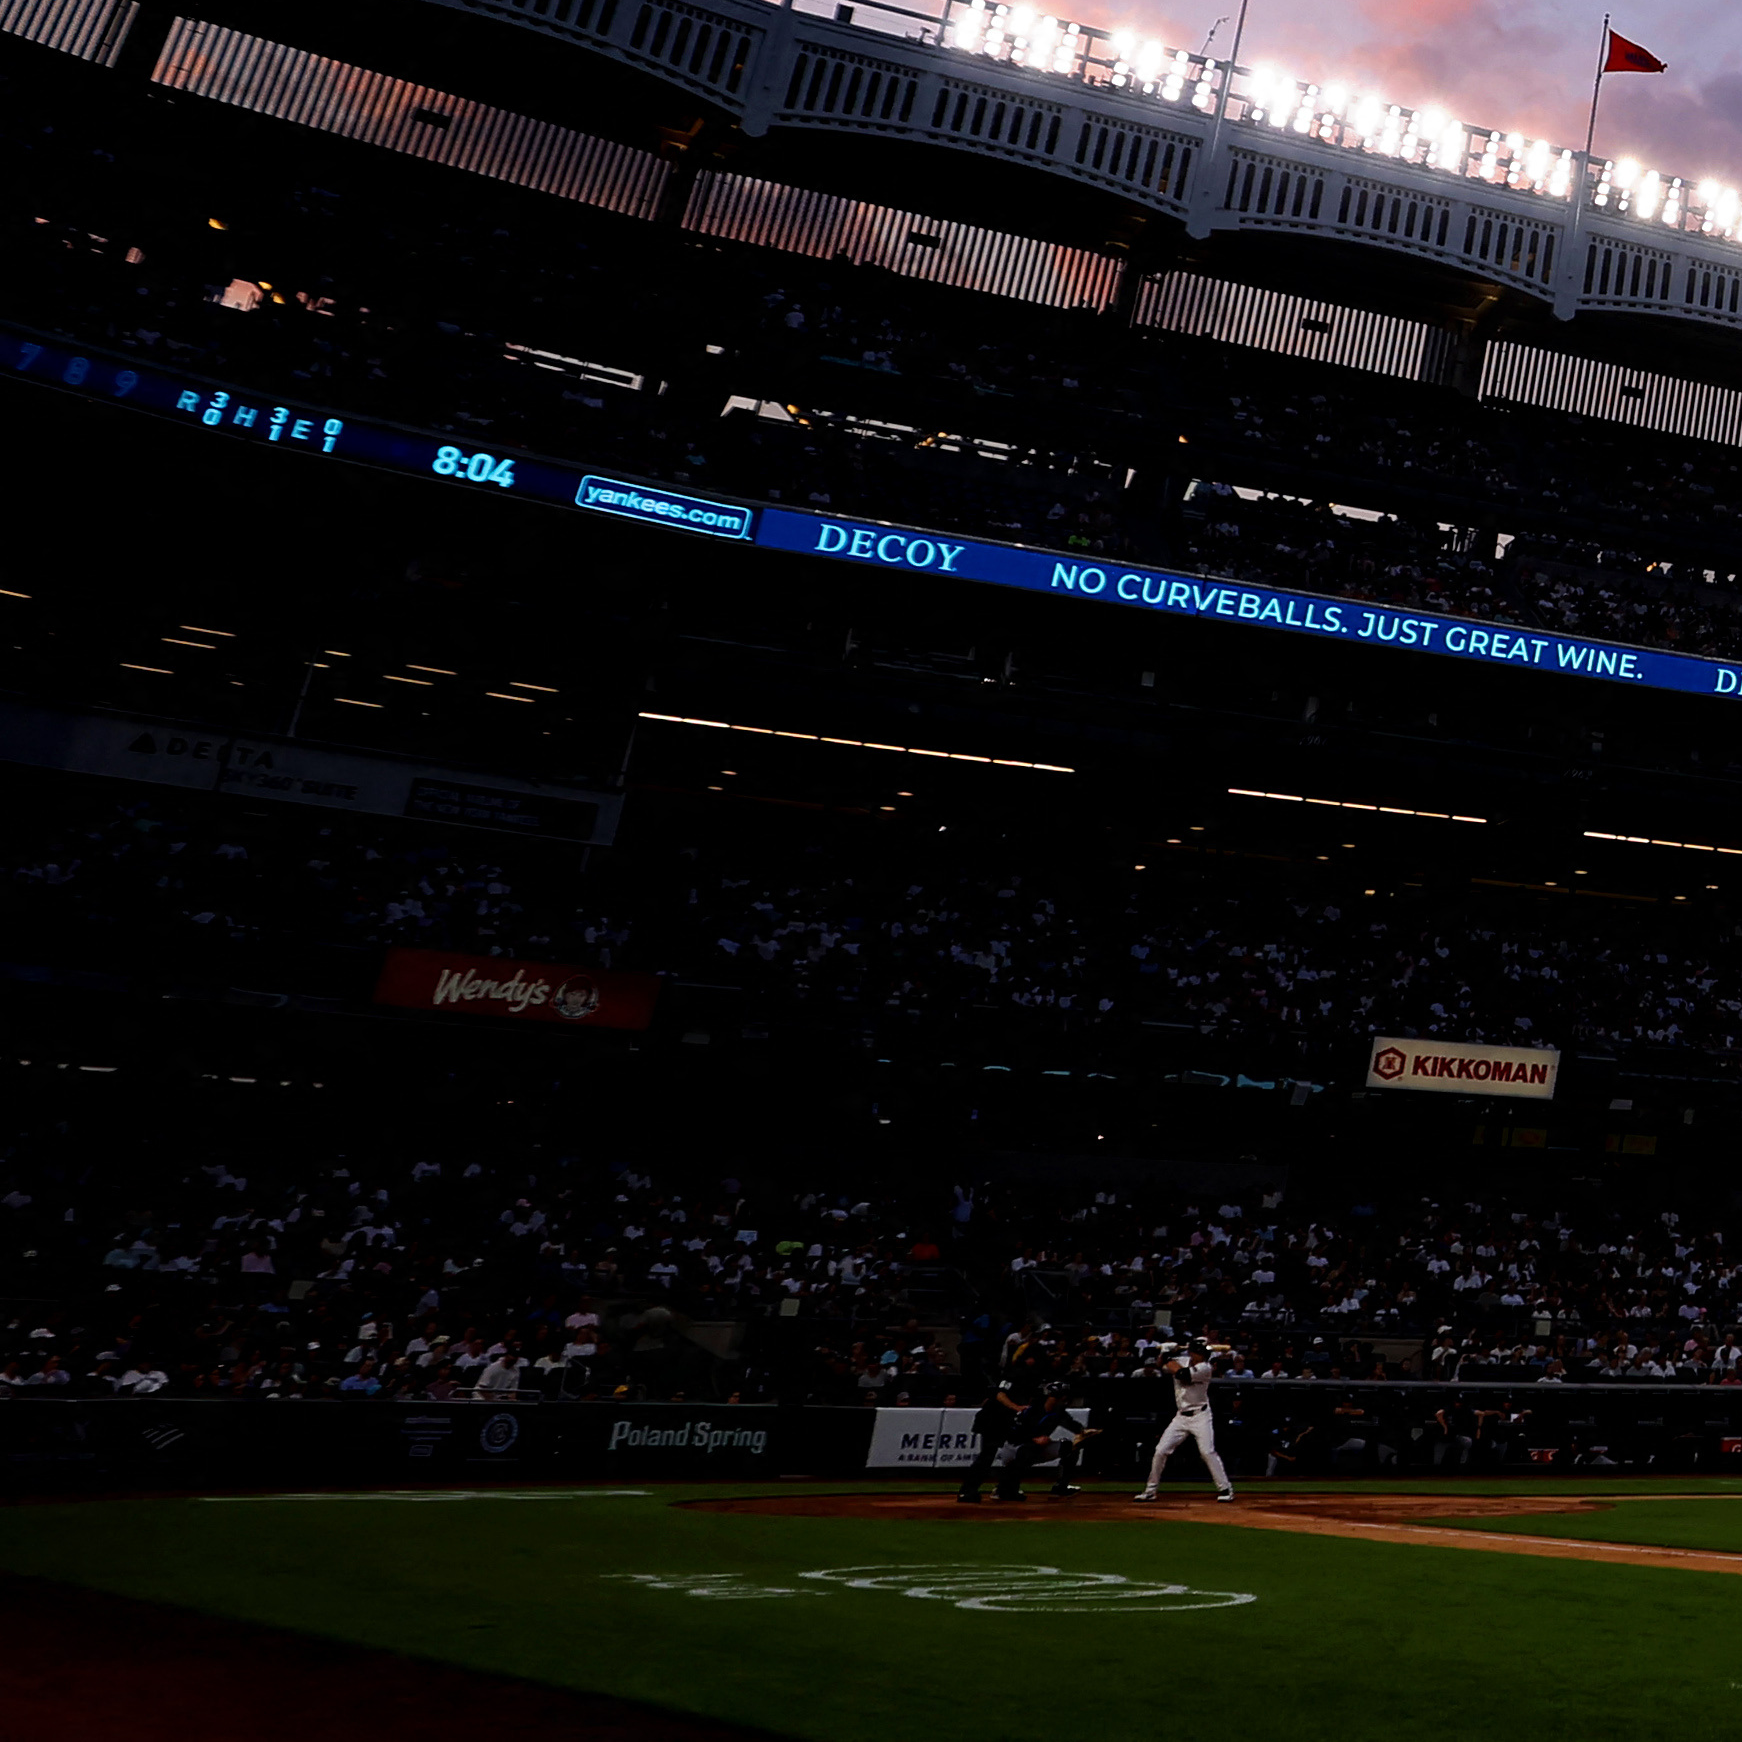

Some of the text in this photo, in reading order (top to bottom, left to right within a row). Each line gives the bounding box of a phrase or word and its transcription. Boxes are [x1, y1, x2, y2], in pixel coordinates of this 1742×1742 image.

[16, 342, 139, 397] 7 8 9
[176, 390, 315, 440] R H E
[202, 408, 337, 453] 0 1 1
[210, 391, 344, 436] 3 3 0
[432, 445, 516, 488] 8:04
[585, 485, 741, 530] yankees.com
[814, 524, 965, 571] DECOY
[1051, 562, 1643, 679] NO CURVEBALLS. JUST GREAT WINE.
[432, 968, 550, 1012] Wendy's
[1412, 1055, 1548, 1085] KIKKOMAN
[607, 1421, 768, 1455] Poland Spring
[901, 1433, 977, 1450] MERRI
